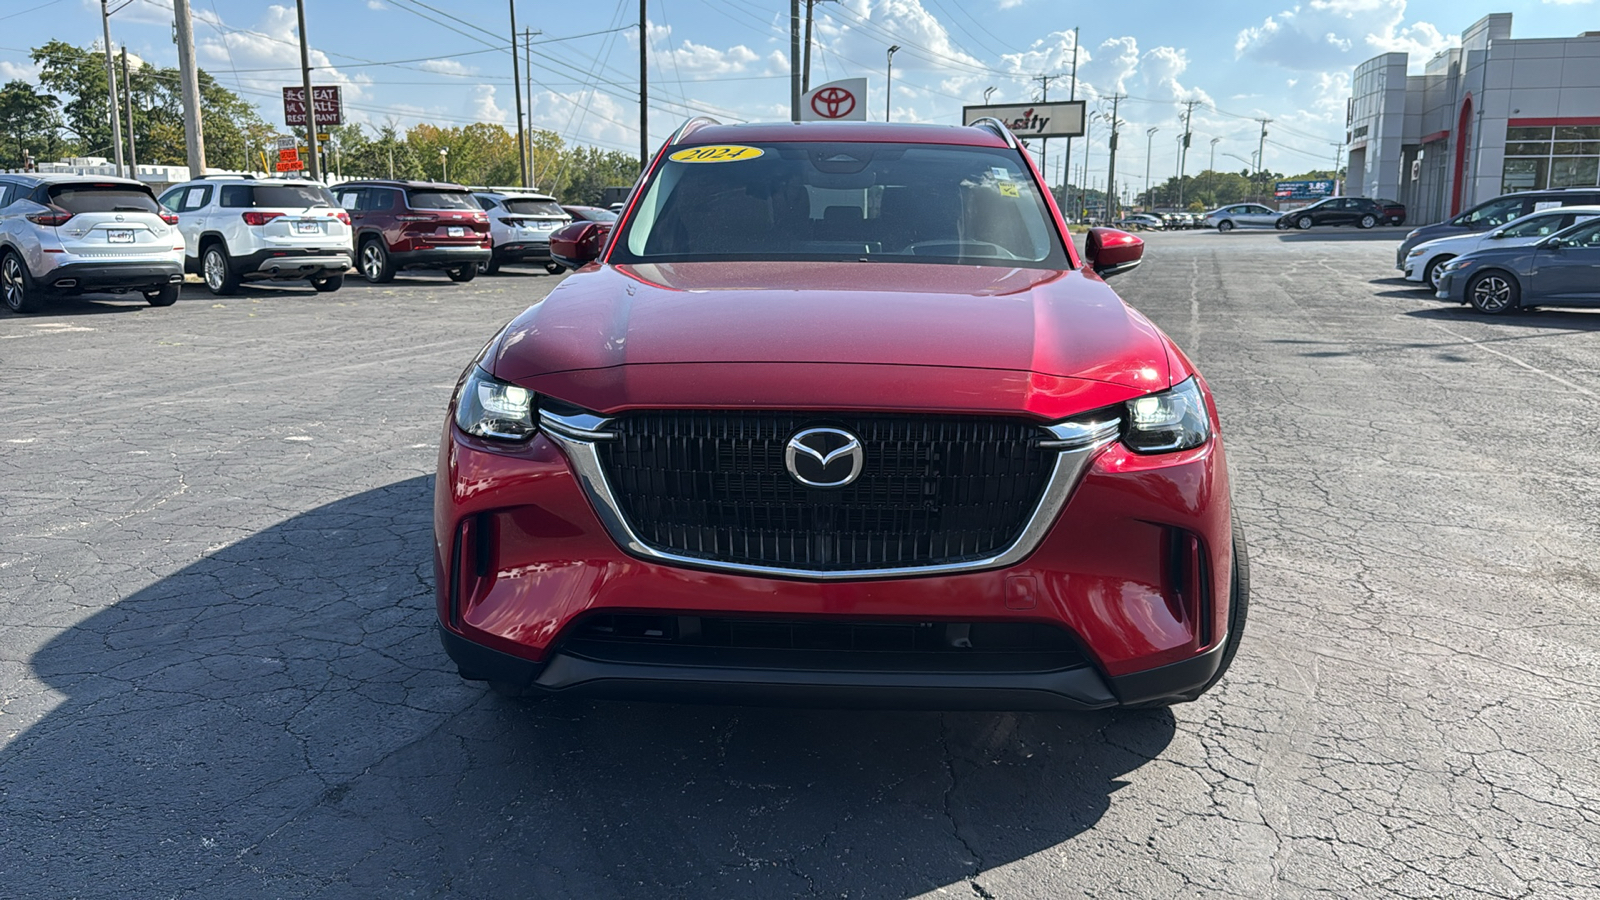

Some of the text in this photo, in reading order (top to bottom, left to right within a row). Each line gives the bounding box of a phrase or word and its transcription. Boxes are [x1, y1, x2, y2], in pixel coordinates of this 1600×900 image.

[297, 89, 335, 100] GEAT
[287, 113, 338, 122] RESTRANT
[681, 148, 749, 161] 2024
